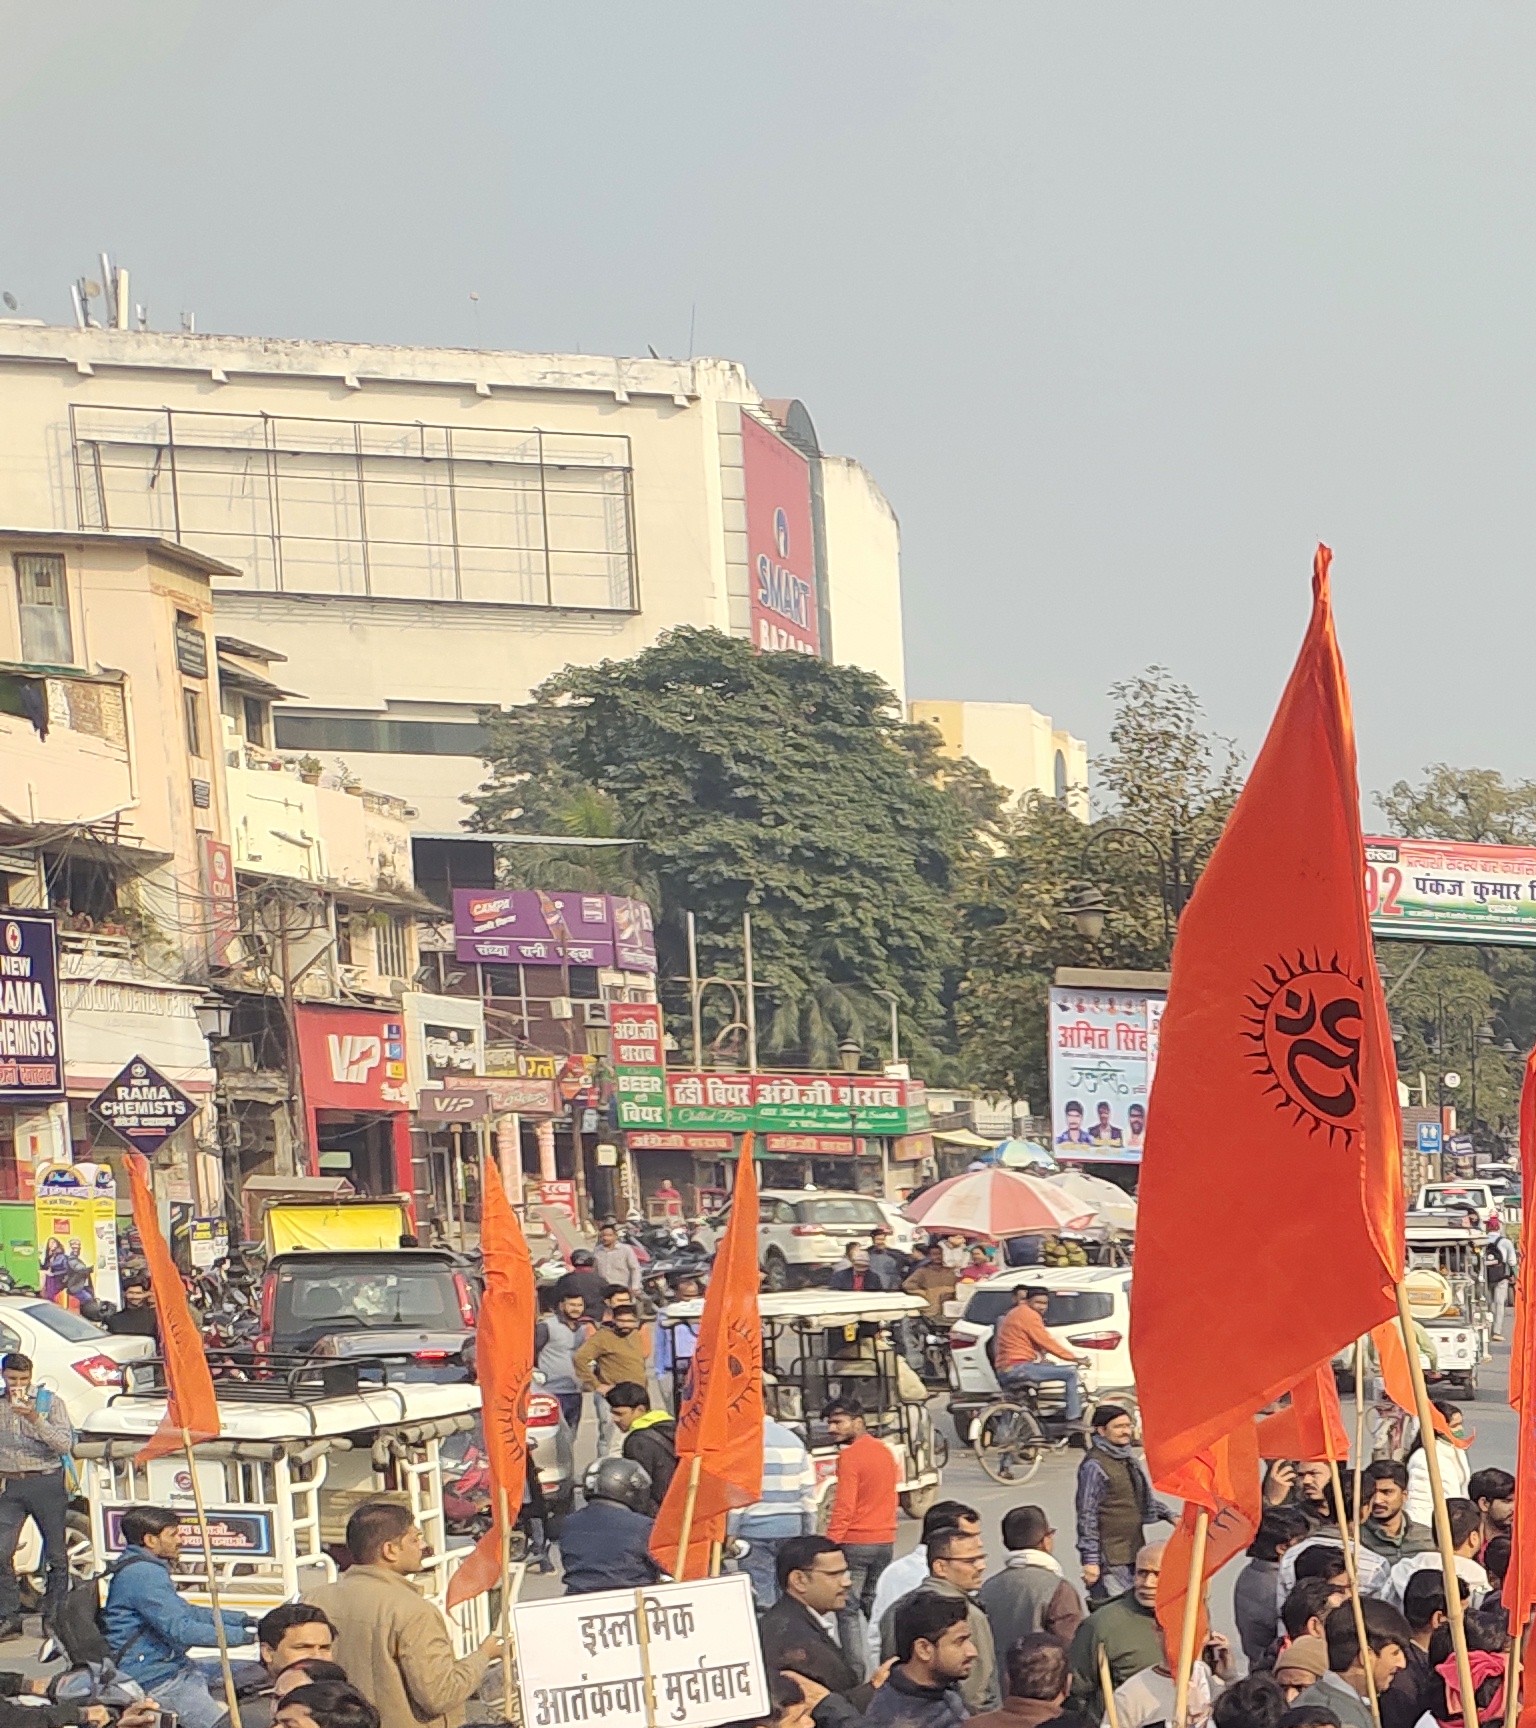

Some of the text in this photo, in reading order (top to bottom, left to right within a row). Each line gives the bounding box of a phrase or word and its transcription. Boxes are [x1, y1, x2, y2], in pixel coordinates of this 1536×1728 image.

[757, 553, 810, 631] SMART
[1413, 872, 1464, 897] पंकज
[1471, 881, 1522, 903] कुमार
[518, 943, 548, 959] रानी
[1, 956, 31, 977] NEW
[0, 1020, 56, 1058] HEMISTS
[1058, 1021, 1110, 1050] अमित
[327, 1034, 381, 1083] VIP
[117, 1087, 171, 1100] RAMA
[618, 1076, 662, 1093] BEER
[756, 1079, 833, 1106] अंग्रेजी
[101, 1101, 187, 1115] CHEMISTS
[433, 1097, 474, 1112] VIP
[578, 1596, 695, 1657] इस्लामिक
[662, 1655, 752, 1722] मुर्दाबाद
